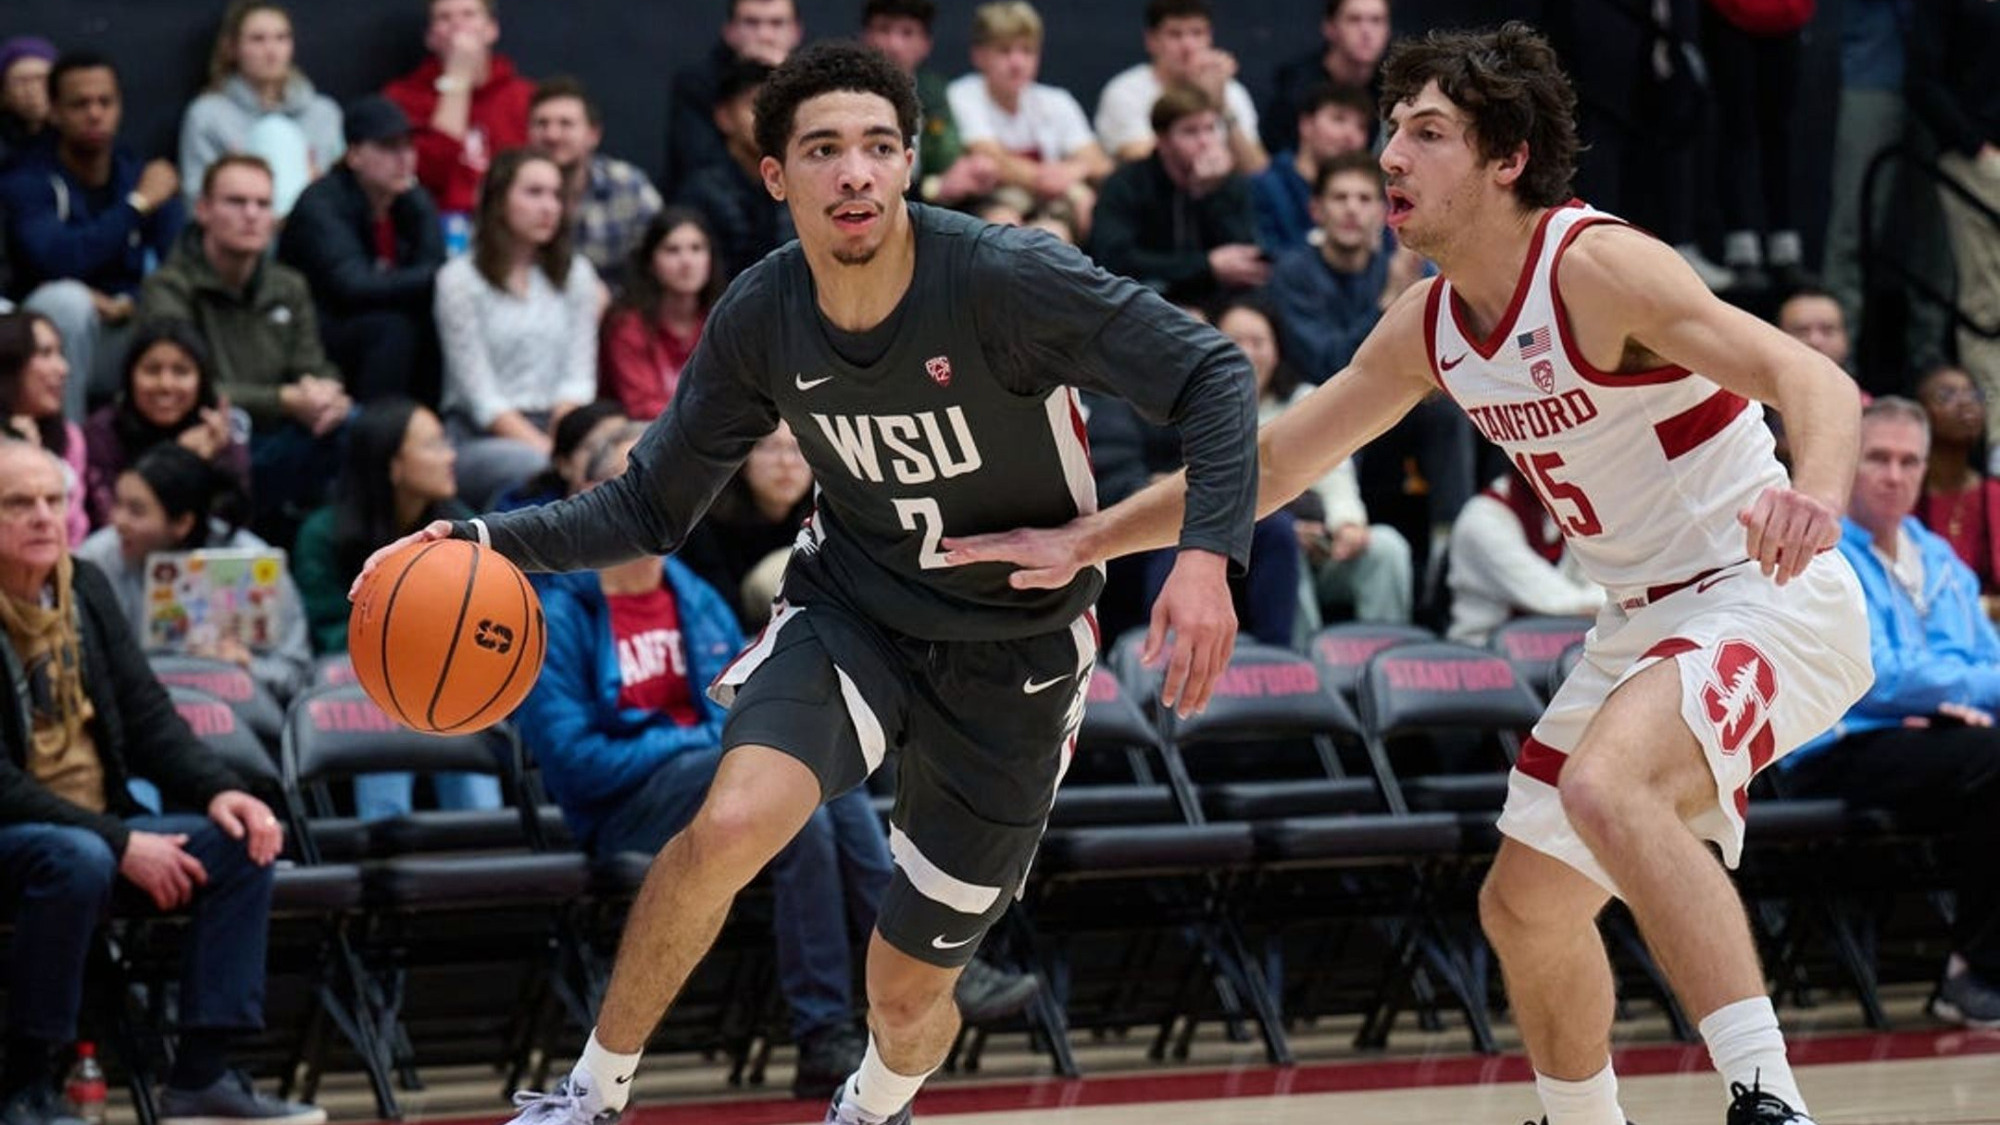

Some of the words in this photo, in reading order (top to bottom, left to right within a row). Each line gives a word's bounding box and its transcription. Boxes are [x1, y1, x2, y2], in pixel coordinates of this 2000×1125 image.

[809, 405, 982, 485] WSU
[1467, 388, 1598, 441] TANFORD
[889, 497, 958, 570] 2
[1213, 661, 1320, 696] ANFORD
